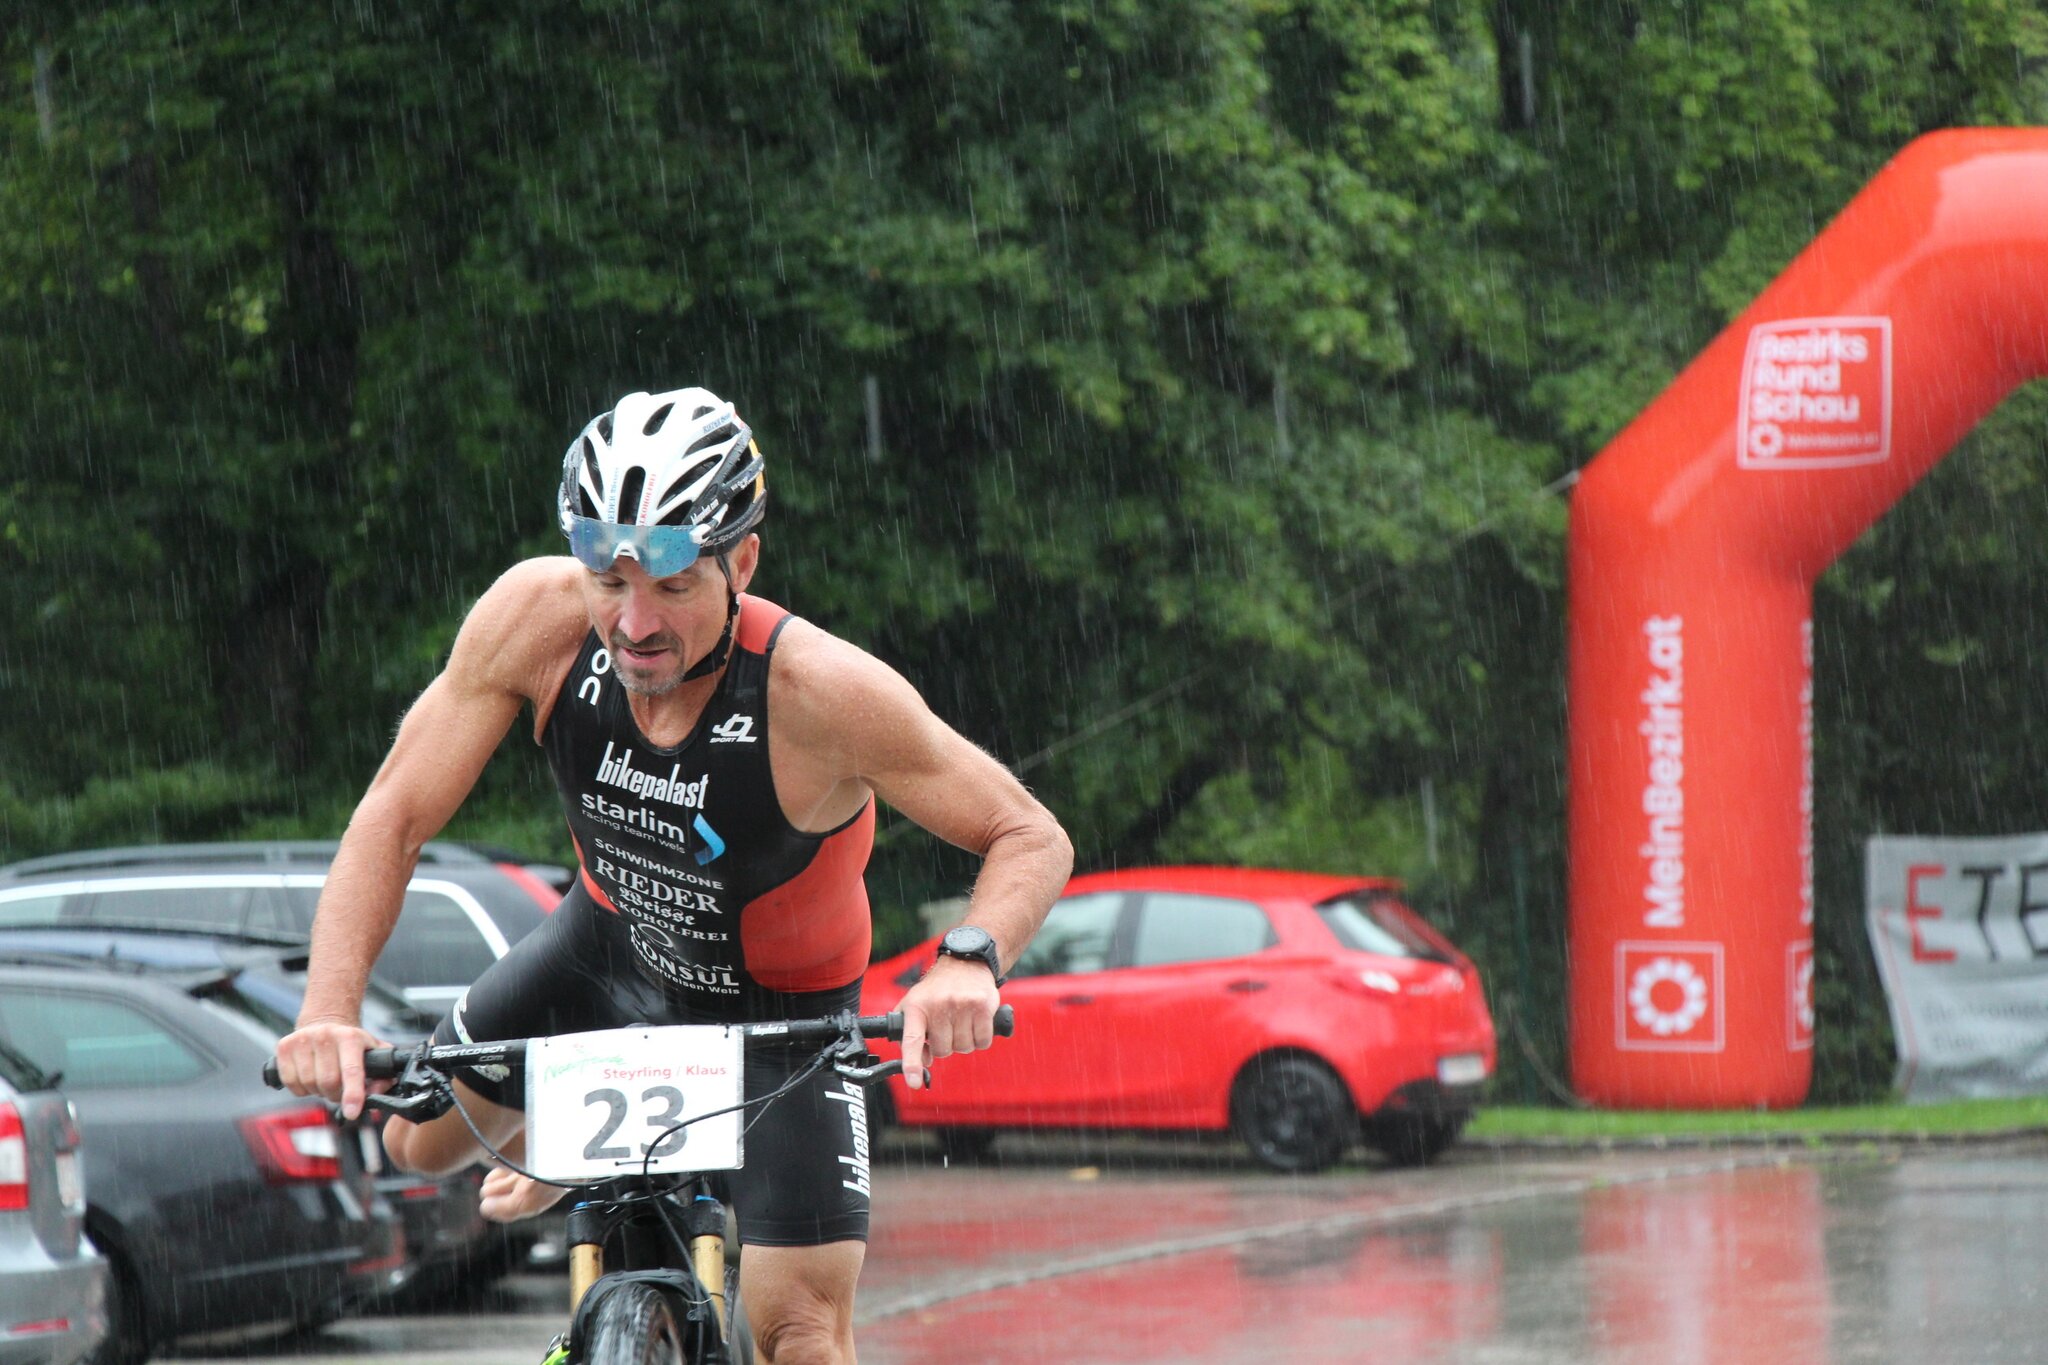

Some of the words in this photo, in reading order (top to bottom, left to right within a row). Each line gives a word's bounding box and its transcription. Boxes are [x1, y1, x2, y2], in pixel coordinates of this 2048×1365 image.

[1758, 328, 1869, 364] Bezirks
[1755, 359, 1842, 392] Rund
[1752, 390, 1861, 423] Schau
[595, 741, 709, 810] bikepalast
[1638, 614, 1685, 928] MeinBezirk.at
[581, 793, 685, 844] starlim
[582, 809, 621, 830] racing
[624, 825, 656, 843] team
[658, 838, 686, 854] wels
[594, 838, 724, 890] SCHWIMMZONE
[594, 856, 723, 914] RIEDER
[619, 887, 696, 926] Weisse
[630, 923, 740, 987] CONSUL
[708, 984, 741, 995] Wels
[603, 1067, 672, 1081] Steyrling
[685, 1065, 727, 1076] Klaus
[583, 1085, 688, 1161] 23
[824, 1080, 871, 1199] bikepala
